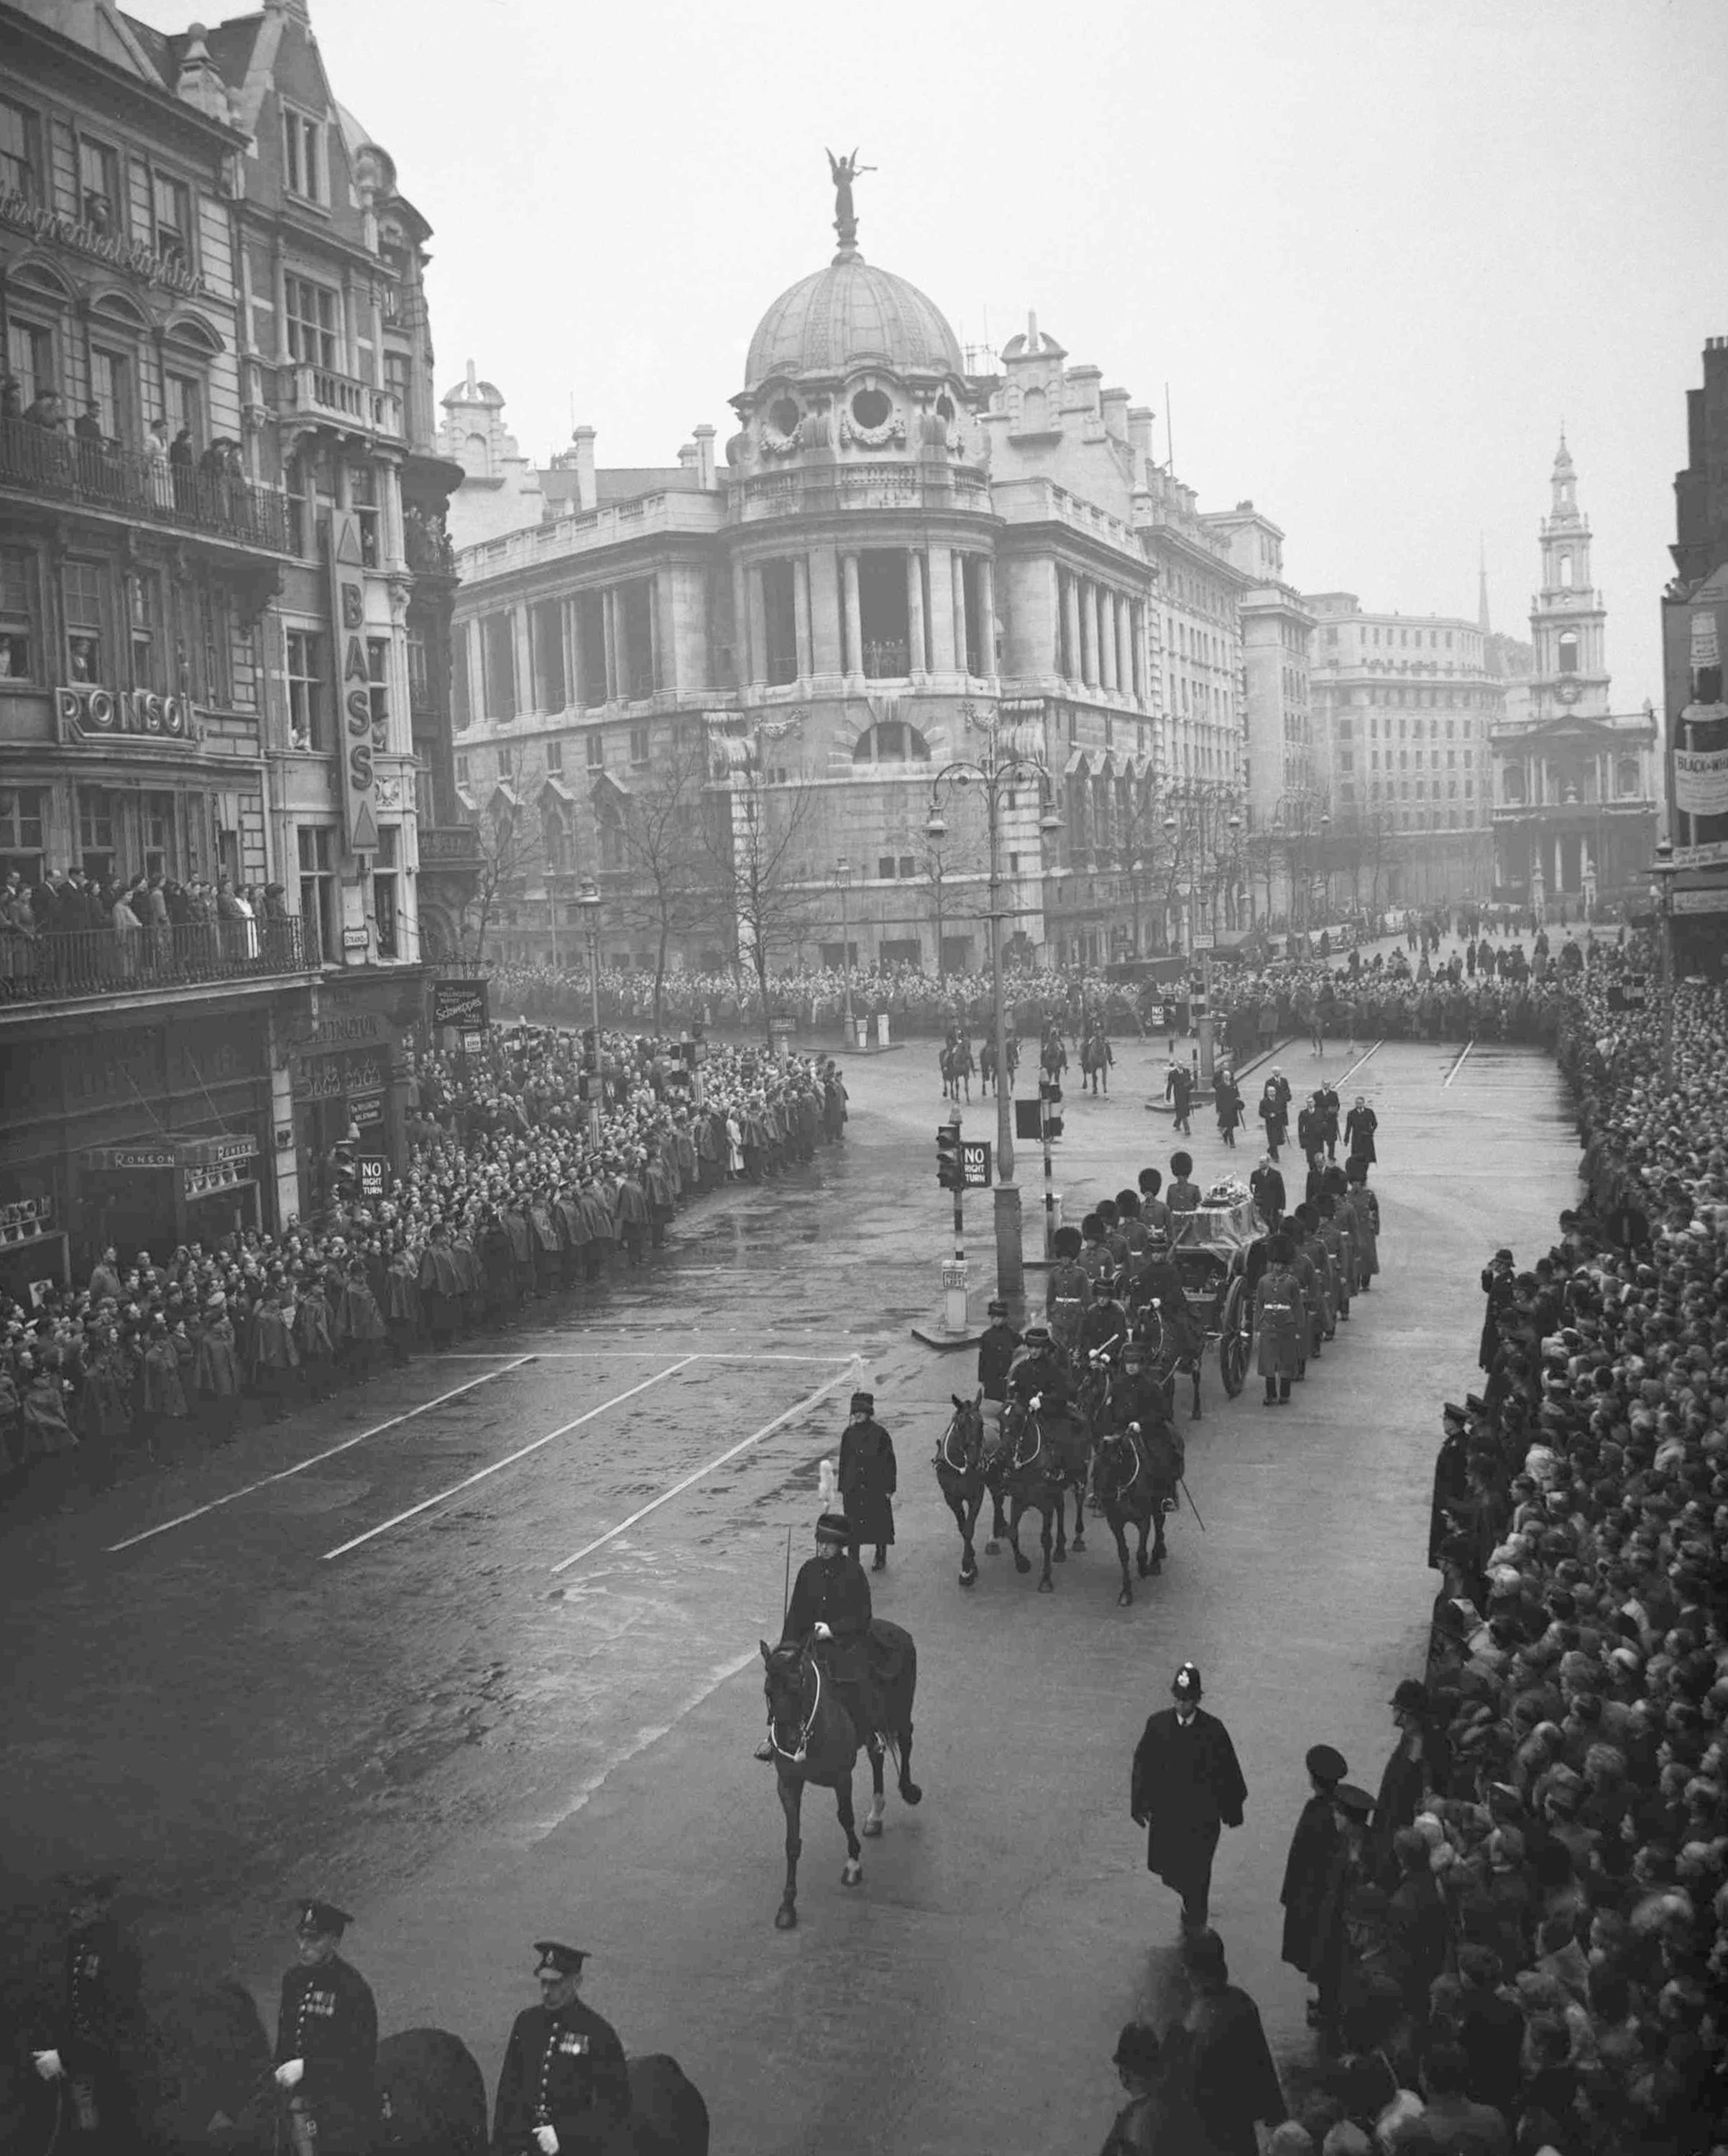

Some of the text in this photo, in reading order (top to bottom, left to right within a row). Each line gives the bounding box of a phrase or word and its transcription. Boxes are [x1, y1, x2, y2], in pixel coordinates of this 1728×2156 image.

[341, 582, 373, 791] BASS
[436, 998, 483, 1021] Schweppes
[1152, 1005, 1164, 1015] NO
[114, 1152, 175, 1169] RONSON
[964, 1148, 985, 1164] NO
[362, 1161, 382, 1176] NO
[964, 1164, 985, 1173] RIGHT
[362, 1177, 382, 1187] RIGHT
[965, 1174, 986, 1183] TURN
[362, 1187, 383, 1195] TURN
